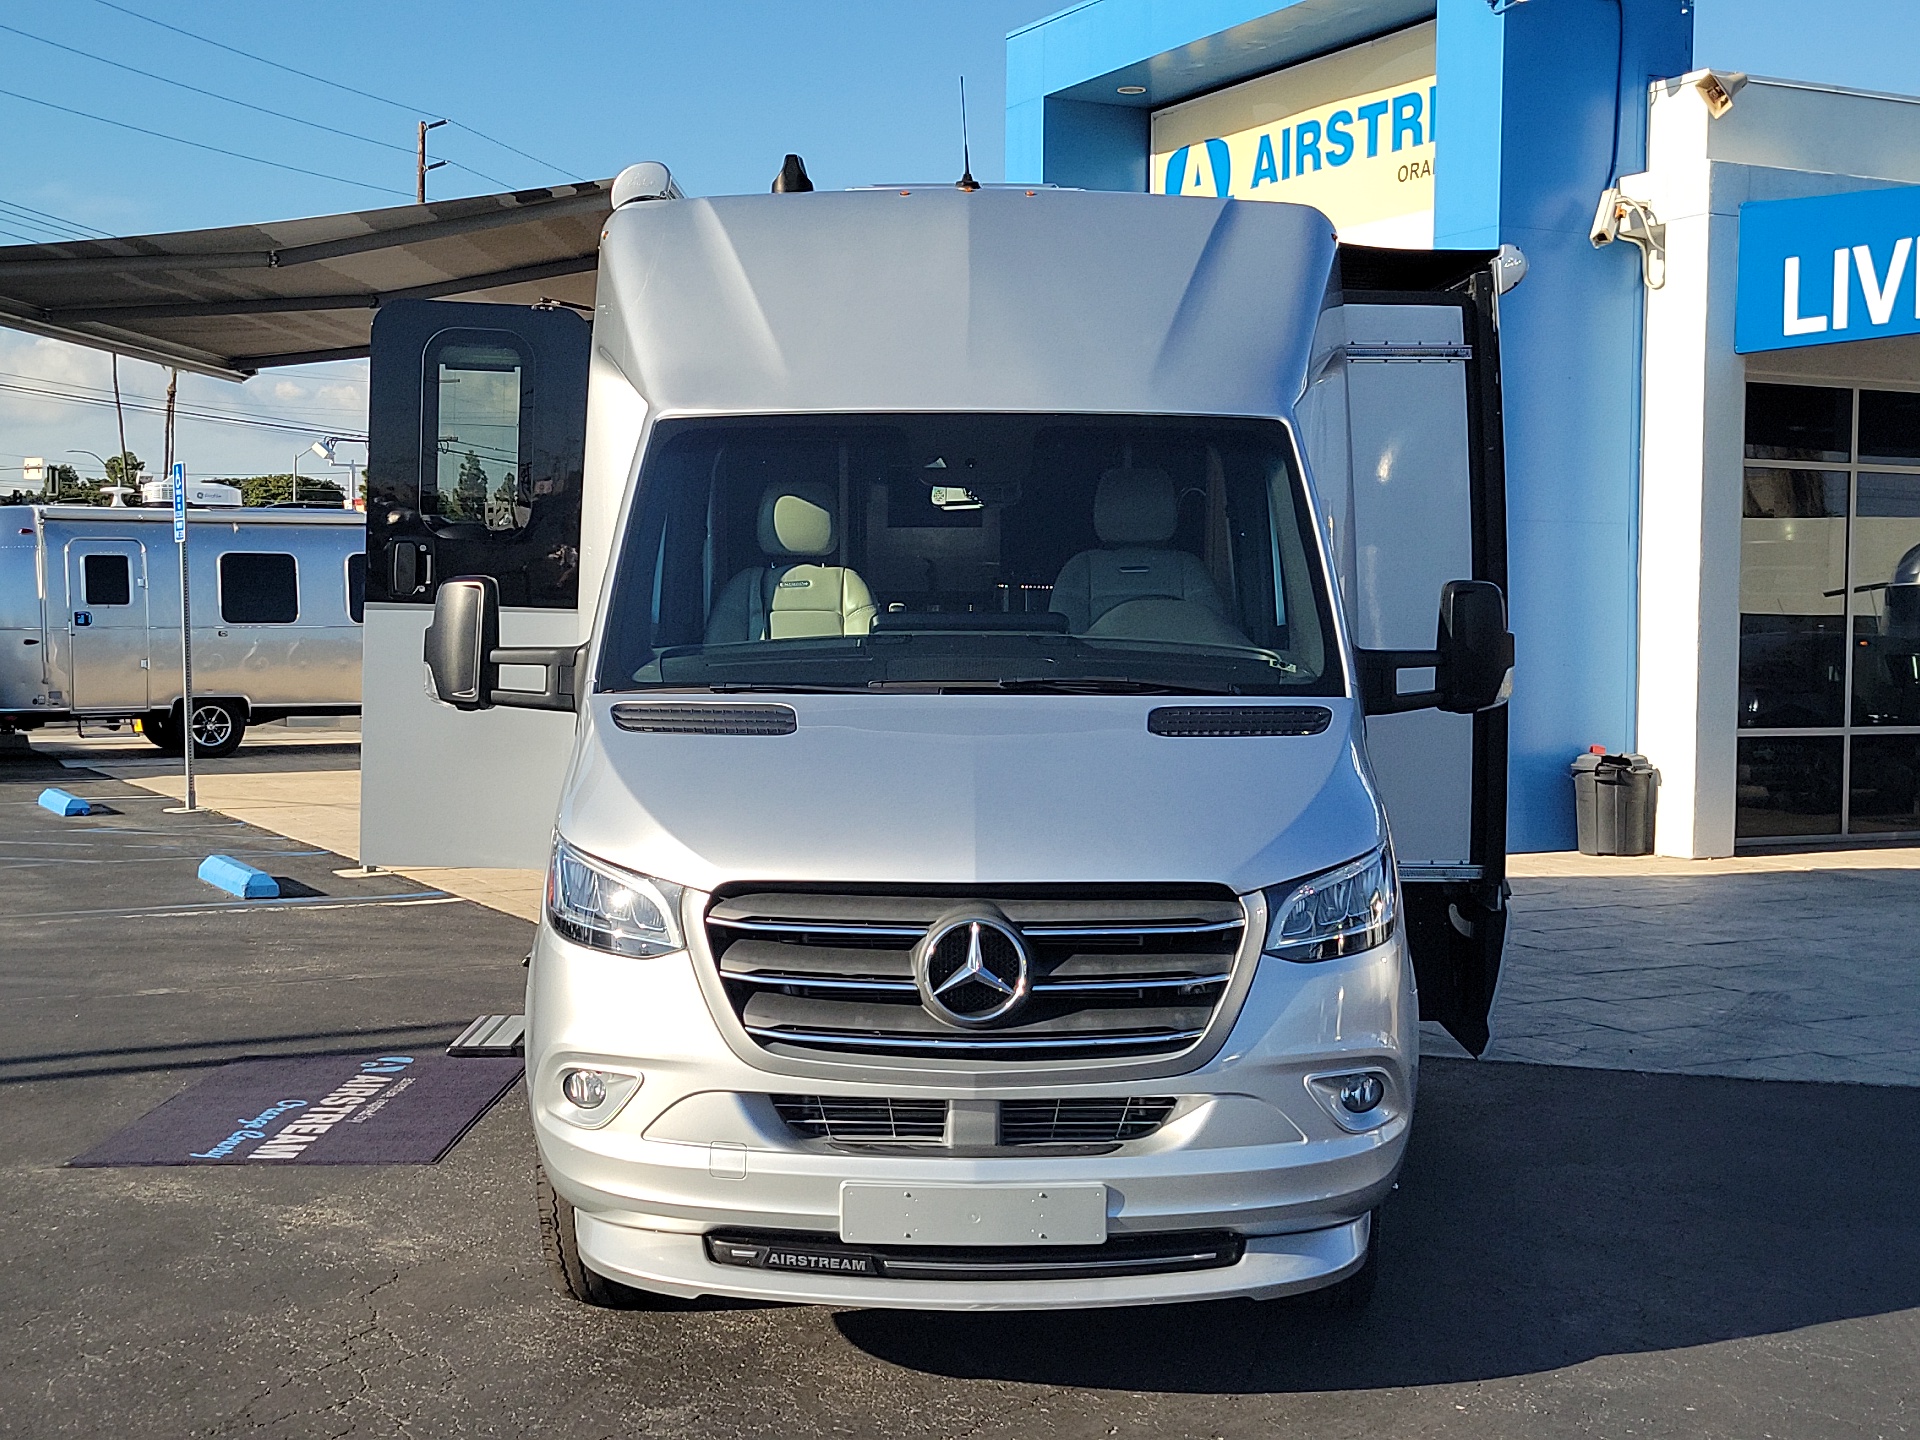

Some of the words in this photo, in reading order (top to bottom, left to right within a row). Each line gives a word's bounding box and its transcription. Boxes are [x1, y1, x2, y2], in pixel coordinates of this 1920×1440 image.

[1250, 86, 1436, 189] AIRSTR
[1397, 158, 1436, 183] ORA
[1783, 236, 1920, 337] LIV
[238, 1099, 308, 1129] Orange
[247, 1074, 393, 1159] AIRSTREAM
[189, 1130, 266, 1159] County
[768, 1253, 866, 1271] AIRSTREAM
